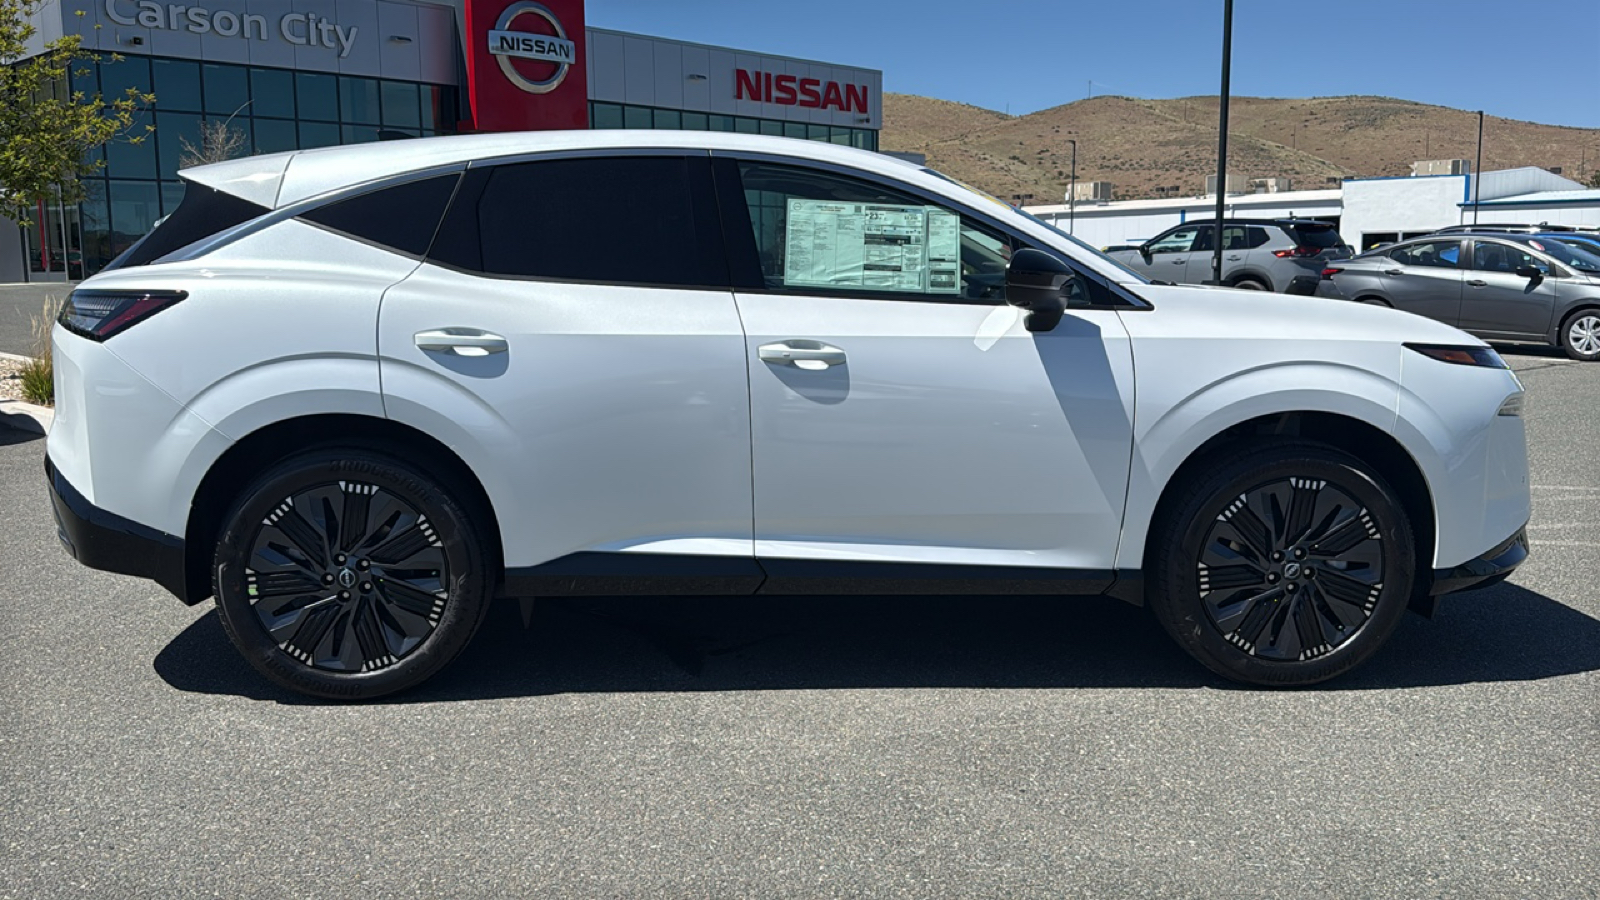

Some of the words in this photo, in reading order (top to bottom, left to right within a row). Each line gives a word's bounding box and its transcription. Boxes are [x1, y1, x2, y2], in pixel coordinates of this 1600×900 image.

[105, 0, 269, 41] Carson
[280, 12, 358, 59] City
[500, 36, 570, 59] NISSAN
[735, 68, 869, 114] NISSAN
